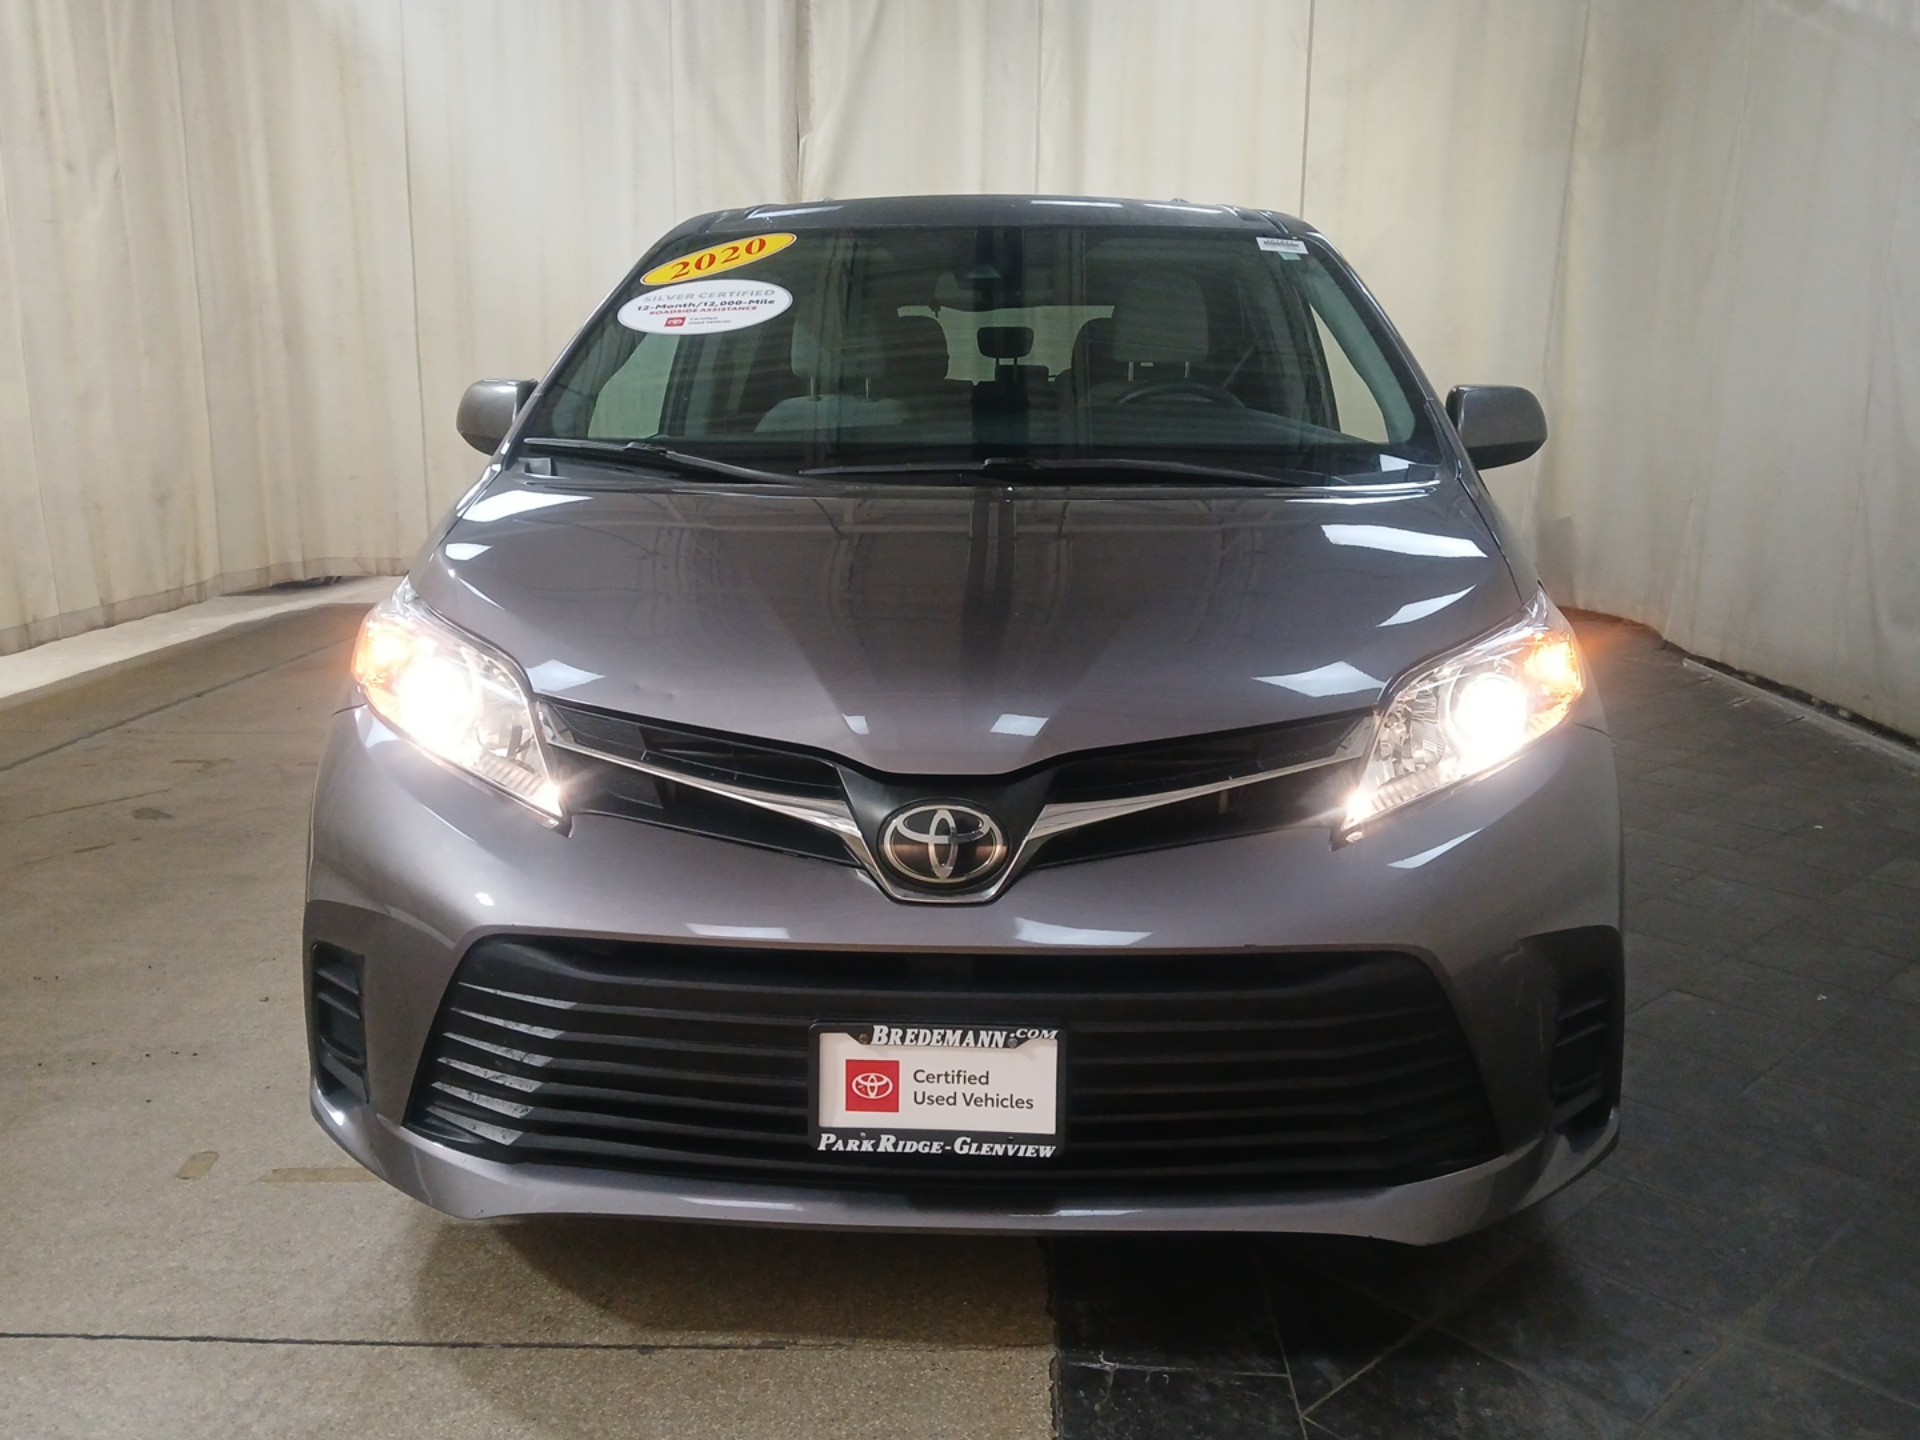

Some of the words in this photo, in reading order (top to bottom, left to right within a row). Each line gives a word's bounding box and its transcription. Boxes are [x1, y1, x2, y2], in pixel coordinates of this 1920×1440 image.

[670, 238, 766, 280] 2020
[643, 293, 695, 302] SILVER
[698, 289, 776, 300] CERTIFIED
[648, 308, 698, 316] ROADSIDE
[699, 305, 758, 313] ASSISTANCE
[912, 1068, 990, 1086] Certified
[912, 1090, 958, 1107] Used
[961, 1092, 1035, 1110] Vehicles
[817, 1133, 876, 1151] PARK
